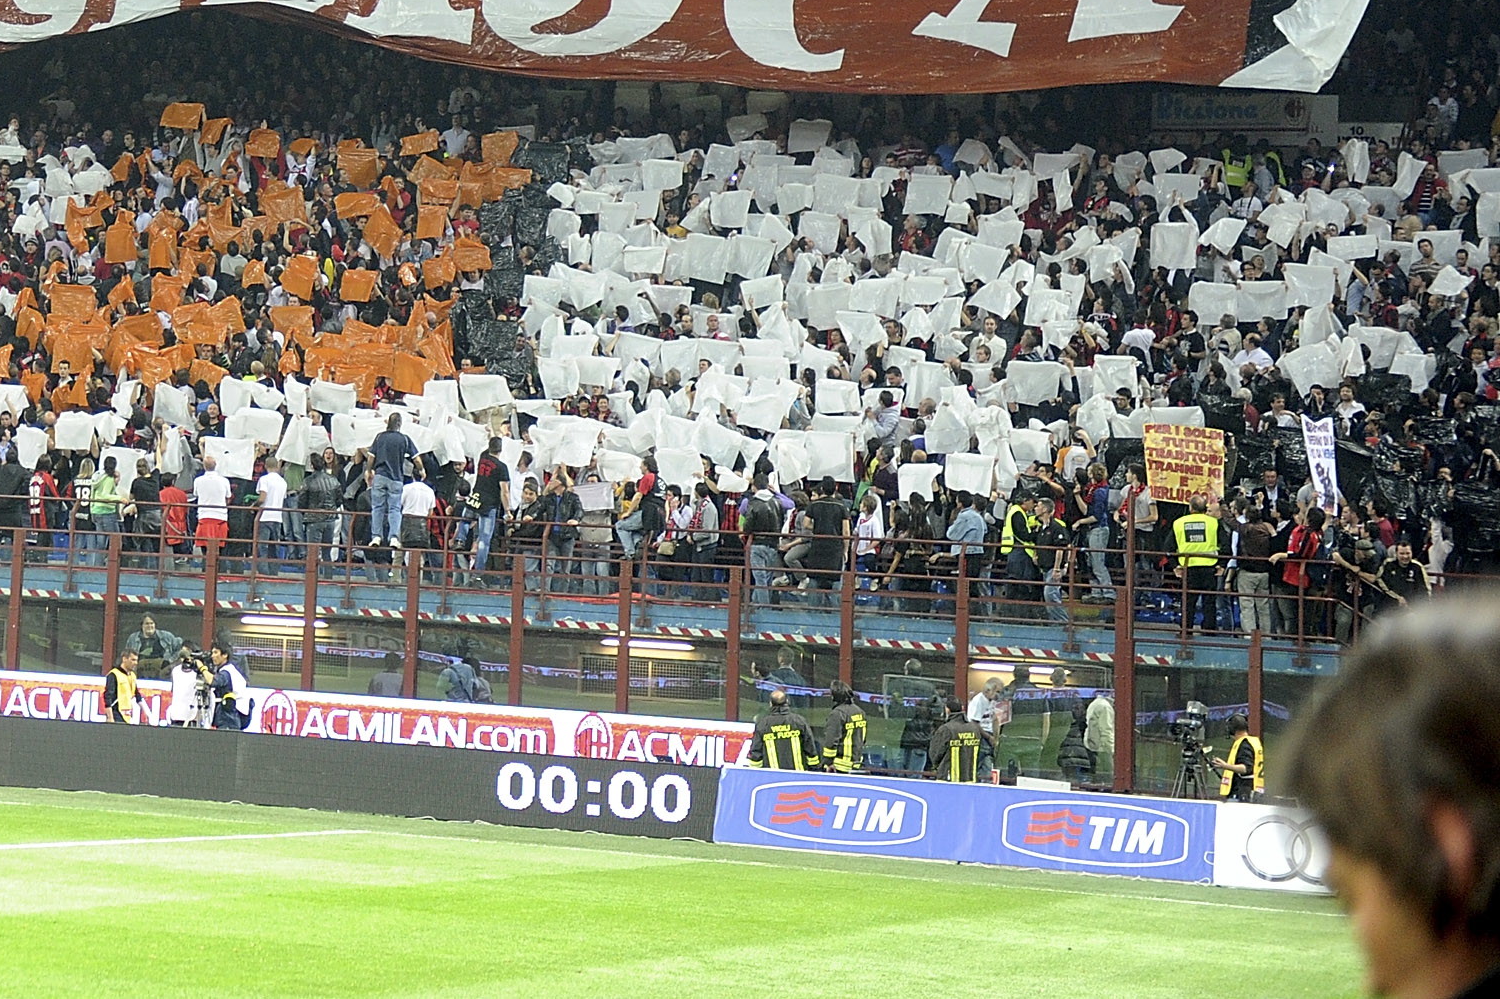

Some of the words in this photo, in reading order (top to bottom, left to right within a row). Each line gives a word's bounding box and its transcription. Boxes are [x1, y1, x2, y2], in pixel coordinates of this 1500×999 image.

[300, 706, 548, 755] ACMILAN.com
[497, 761, 691, 823] 00:00
[829, 796, 907, 834] TIM
[1088, 816, 1167, 856] TIM
